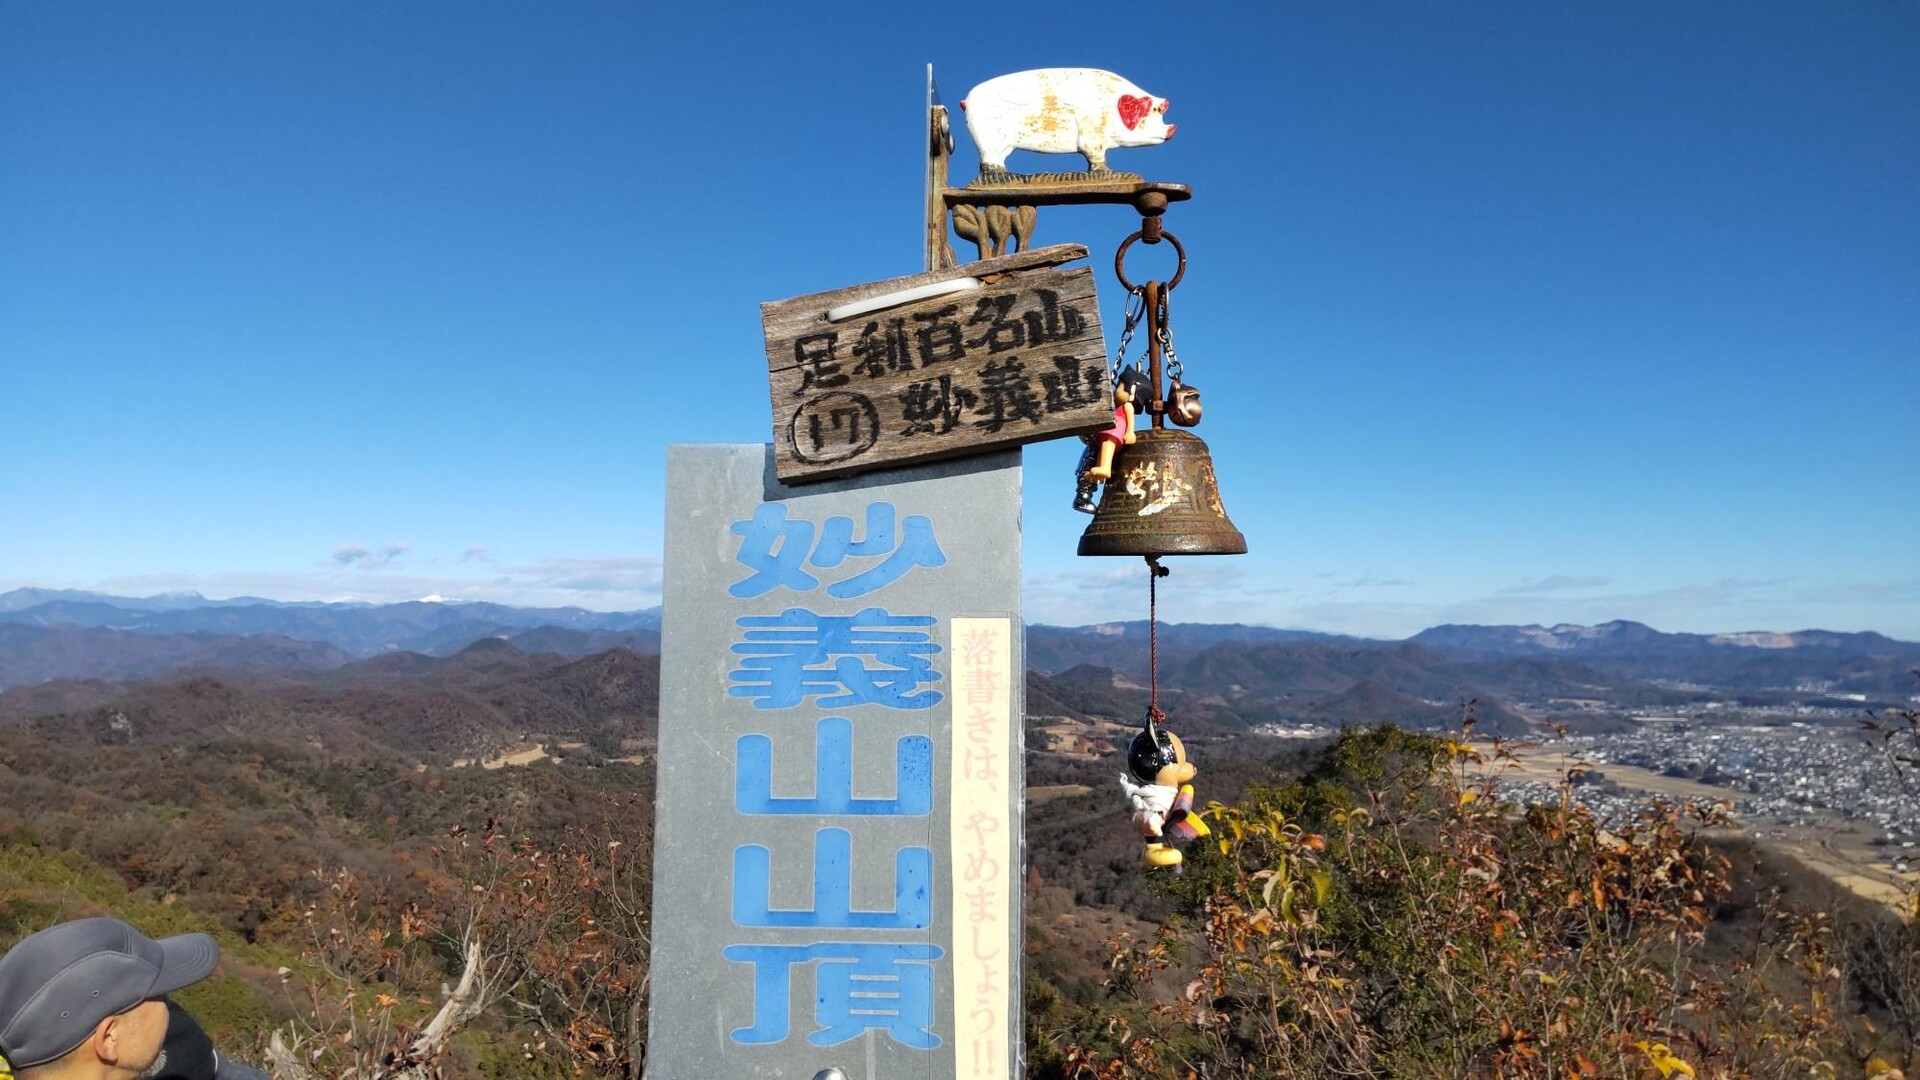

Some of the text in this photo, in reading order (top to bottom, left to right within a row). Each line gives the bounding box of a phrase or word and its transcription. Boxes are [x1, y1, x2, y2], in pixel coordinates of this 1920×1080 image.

[793, 288, 1088, 398] 足利百名山
[899, 355, 1104, 437] 妙義山
[722, 500, 949, 1050] 妙義山山頂
